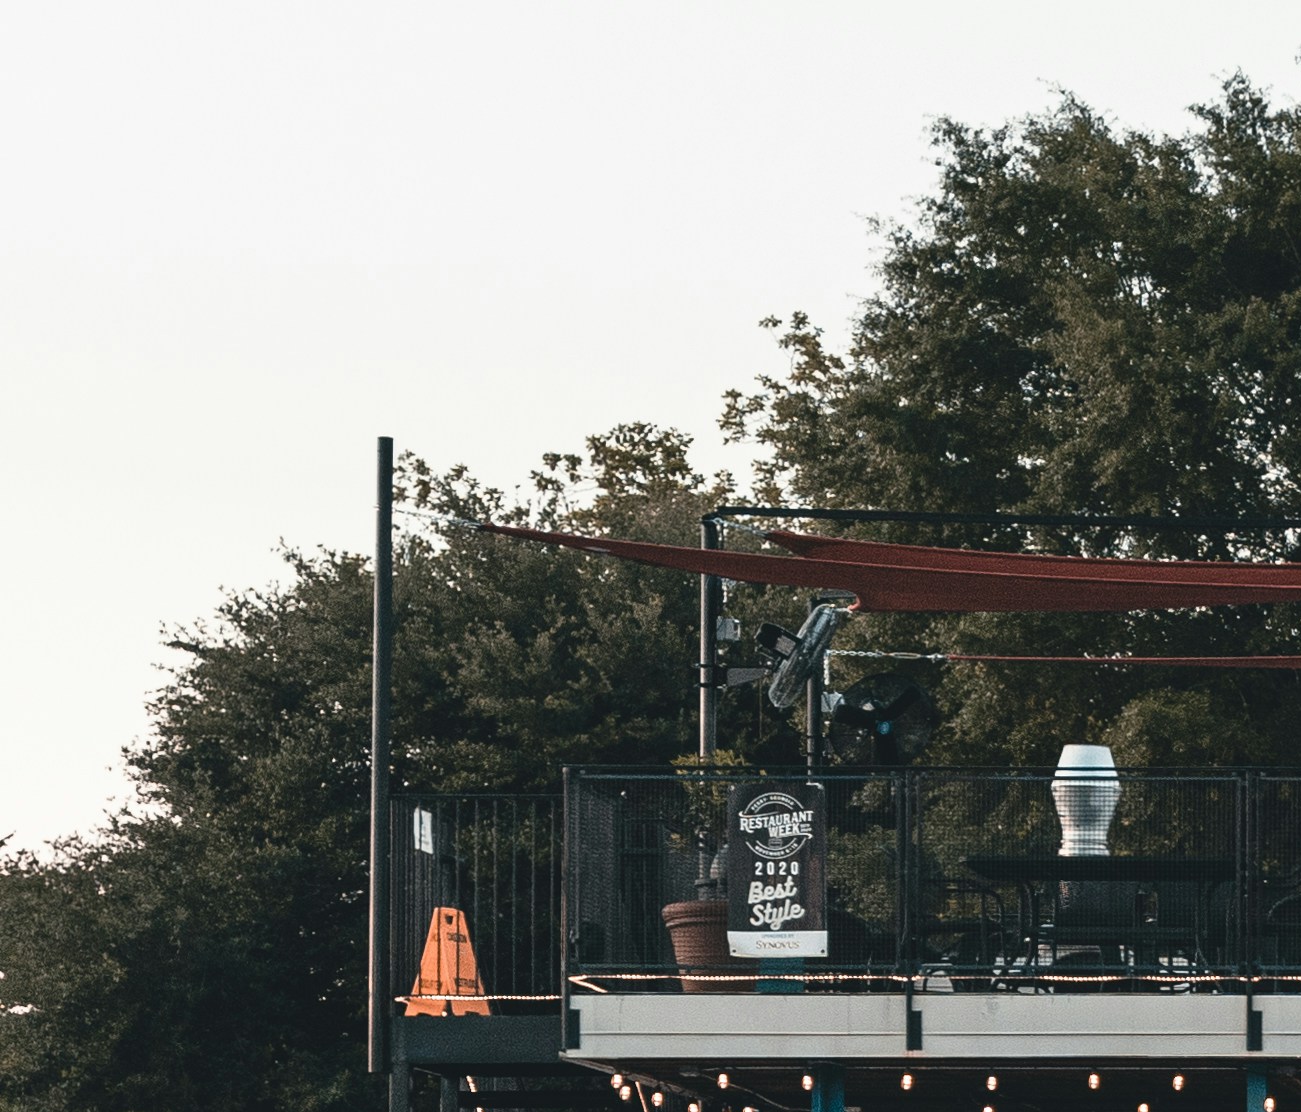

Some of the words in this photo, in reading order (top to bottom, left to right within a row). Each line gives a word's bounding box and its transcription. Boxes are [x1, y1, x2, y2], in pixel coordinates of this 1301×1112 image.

[740, 810, 814, 833] RESTAURANT
[768, 822, 800, 838] WEEK
[755, 861, 798, 875] 2020
[748, 875, 797, 904] Best
[750, 899, 805, 930] Style
